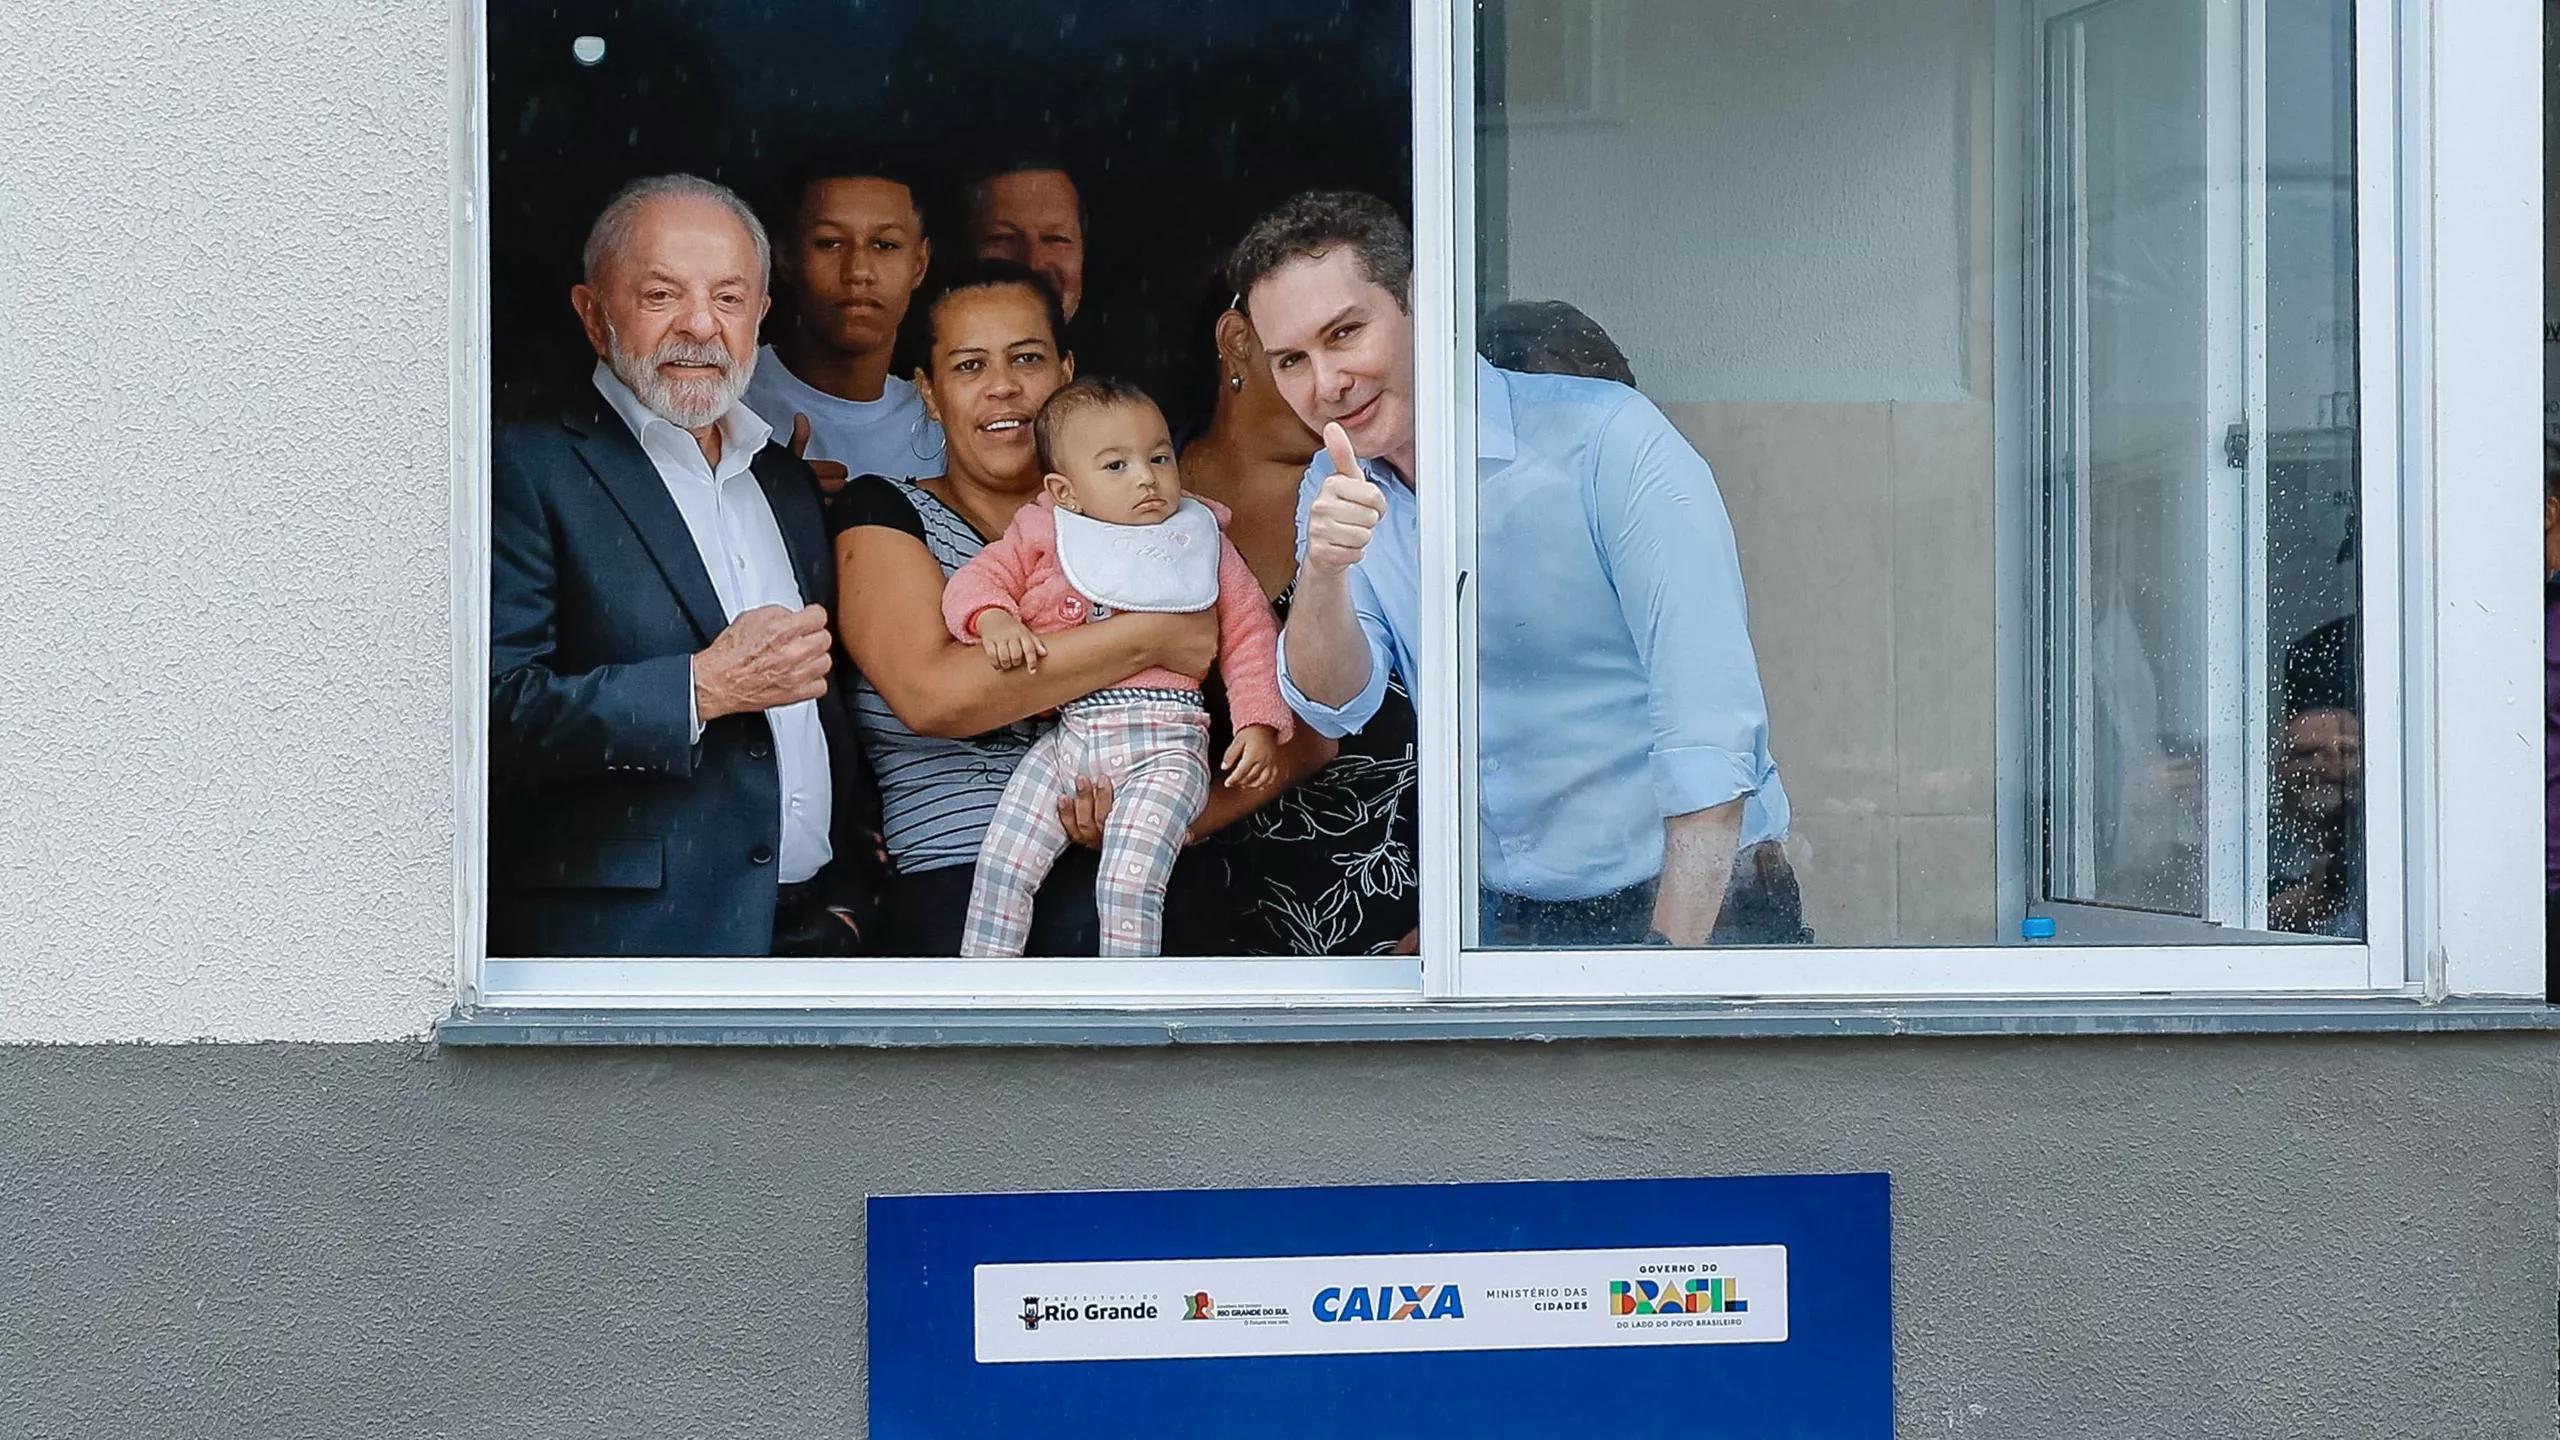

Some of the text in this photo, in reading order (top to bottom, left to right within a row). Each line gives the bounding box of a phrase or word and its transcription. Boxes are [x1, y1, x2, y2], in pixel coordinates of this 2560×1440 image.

[1640, 1263, 1718, 1274] GOVERNO DO
[1486, 1287, 1588, 1299] MINISTÉRIO DAS
[1609, 1277, 1748, 1316] BRASIL
[1312, 1284, 1465, 1324] CAIXA
[1534, 1302, 1588, 1312] CIDADES
[1045, 1302, 1158, 1321] Rio Grande
[1262, 1308, 1274, 1316] DO
[1616, 1321, 1629, 1329] DO
[1656, 1320, 1669, 1328] DO
[1671, 1320, 1694, 1328] POVO
[1696, 1319, 1742, 1327] BRASILEIRO
